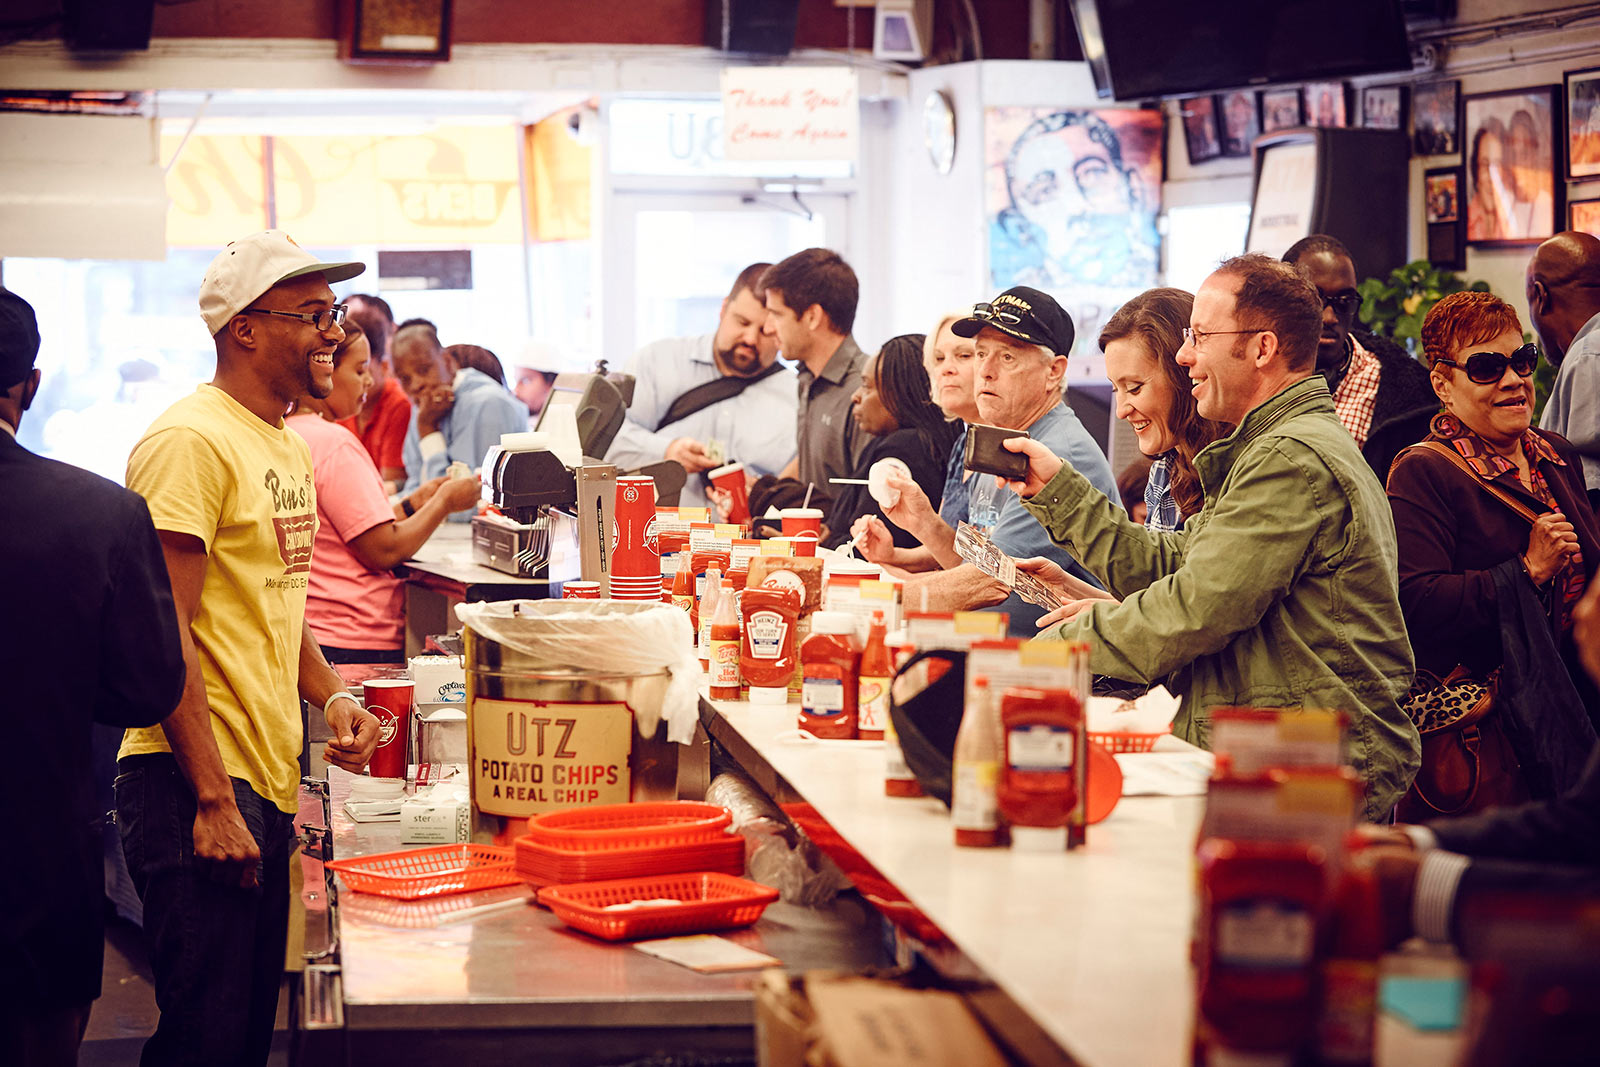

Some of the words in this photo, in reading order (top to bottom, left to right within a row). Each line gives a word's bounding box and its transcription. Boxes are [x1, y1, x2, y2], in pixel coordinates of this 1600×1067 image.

[729, 88, 792, 107] Thank
[730, 122, 783, 144] Come
[785, 121, 848, 144] Again
[265, 468, 306, 512] Ben's
[717, 674, 738, 682] Sauce
[722, 668, 735, 676] Hot
[506, 711, 577, 759] UTZ
[482, 758, 544, 784] POTATO
[552, 764, 619, 785] CHIPS
[493, 784, 501, 799] A
[506, 786, 548, 803] REAL
[553, 789, 599, 804] CHIP
